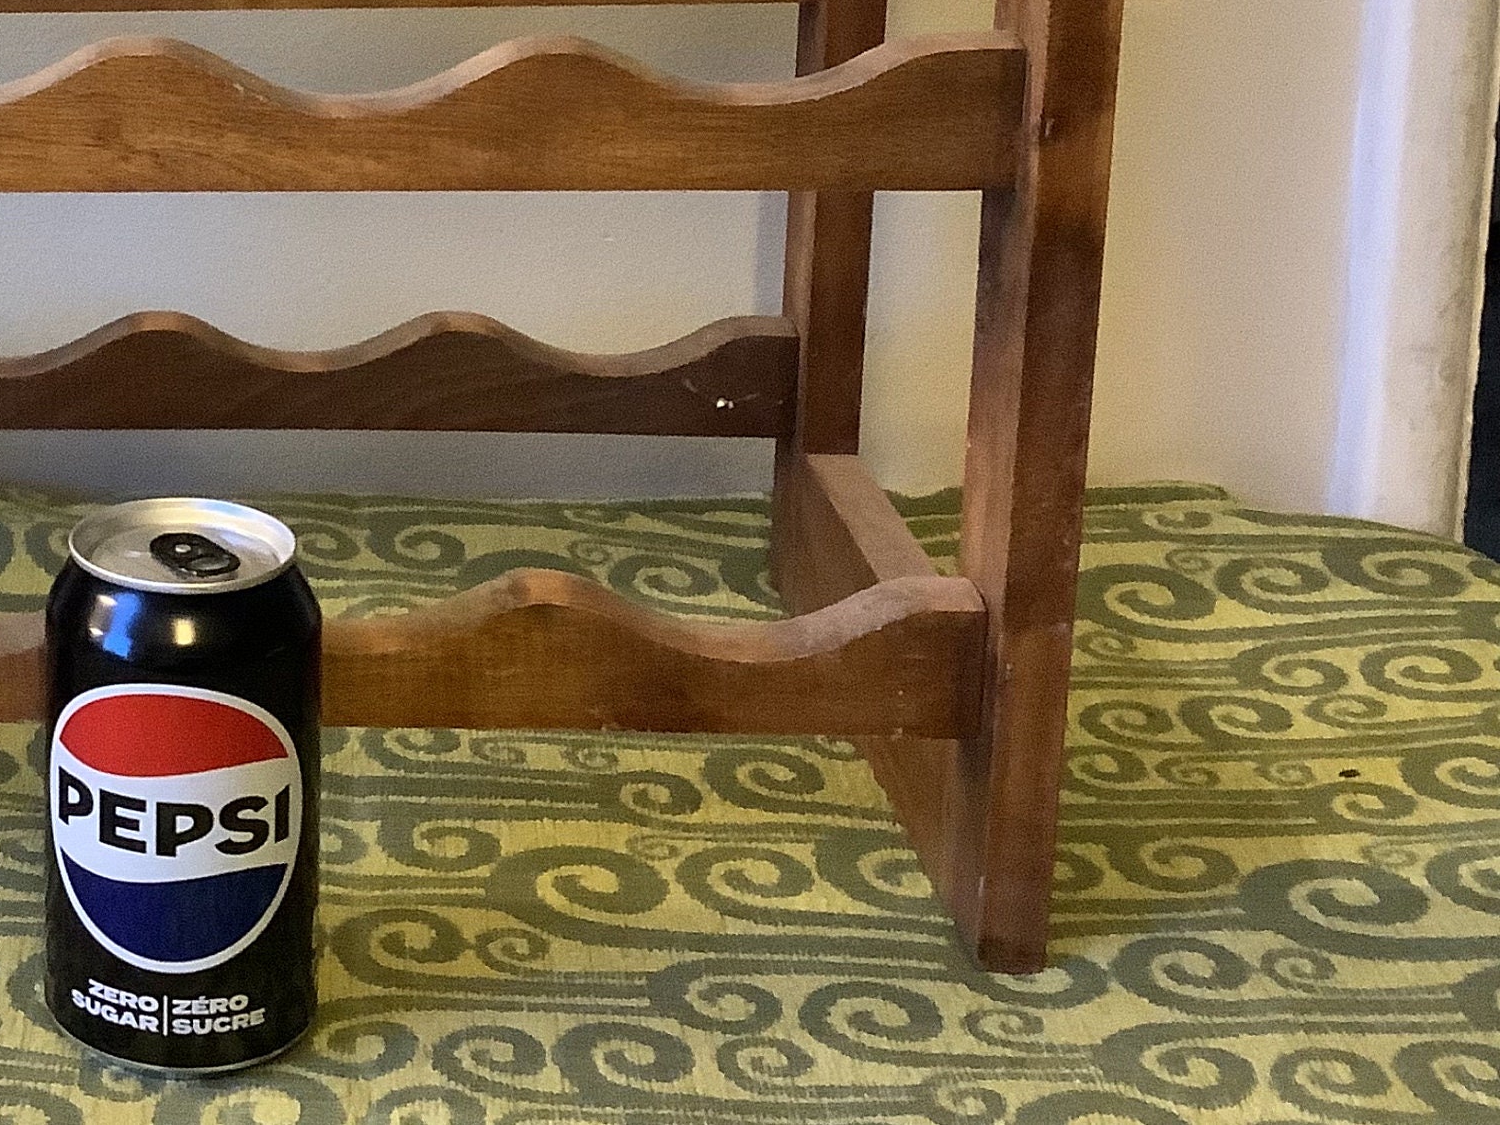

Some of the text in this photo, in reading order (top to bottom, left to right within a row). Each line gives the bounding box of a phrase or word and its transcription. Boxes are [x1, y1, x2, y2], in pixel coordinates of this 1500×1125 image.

[58, 765, 290, 858] PEPSI
[71, 989, 160, 1033] SUGAR
[88, 978, 160, 1013] ZERO
[171, 994, 250, 1016] ZÉRO
[171, 1007, 266, 1035] SUCRE
